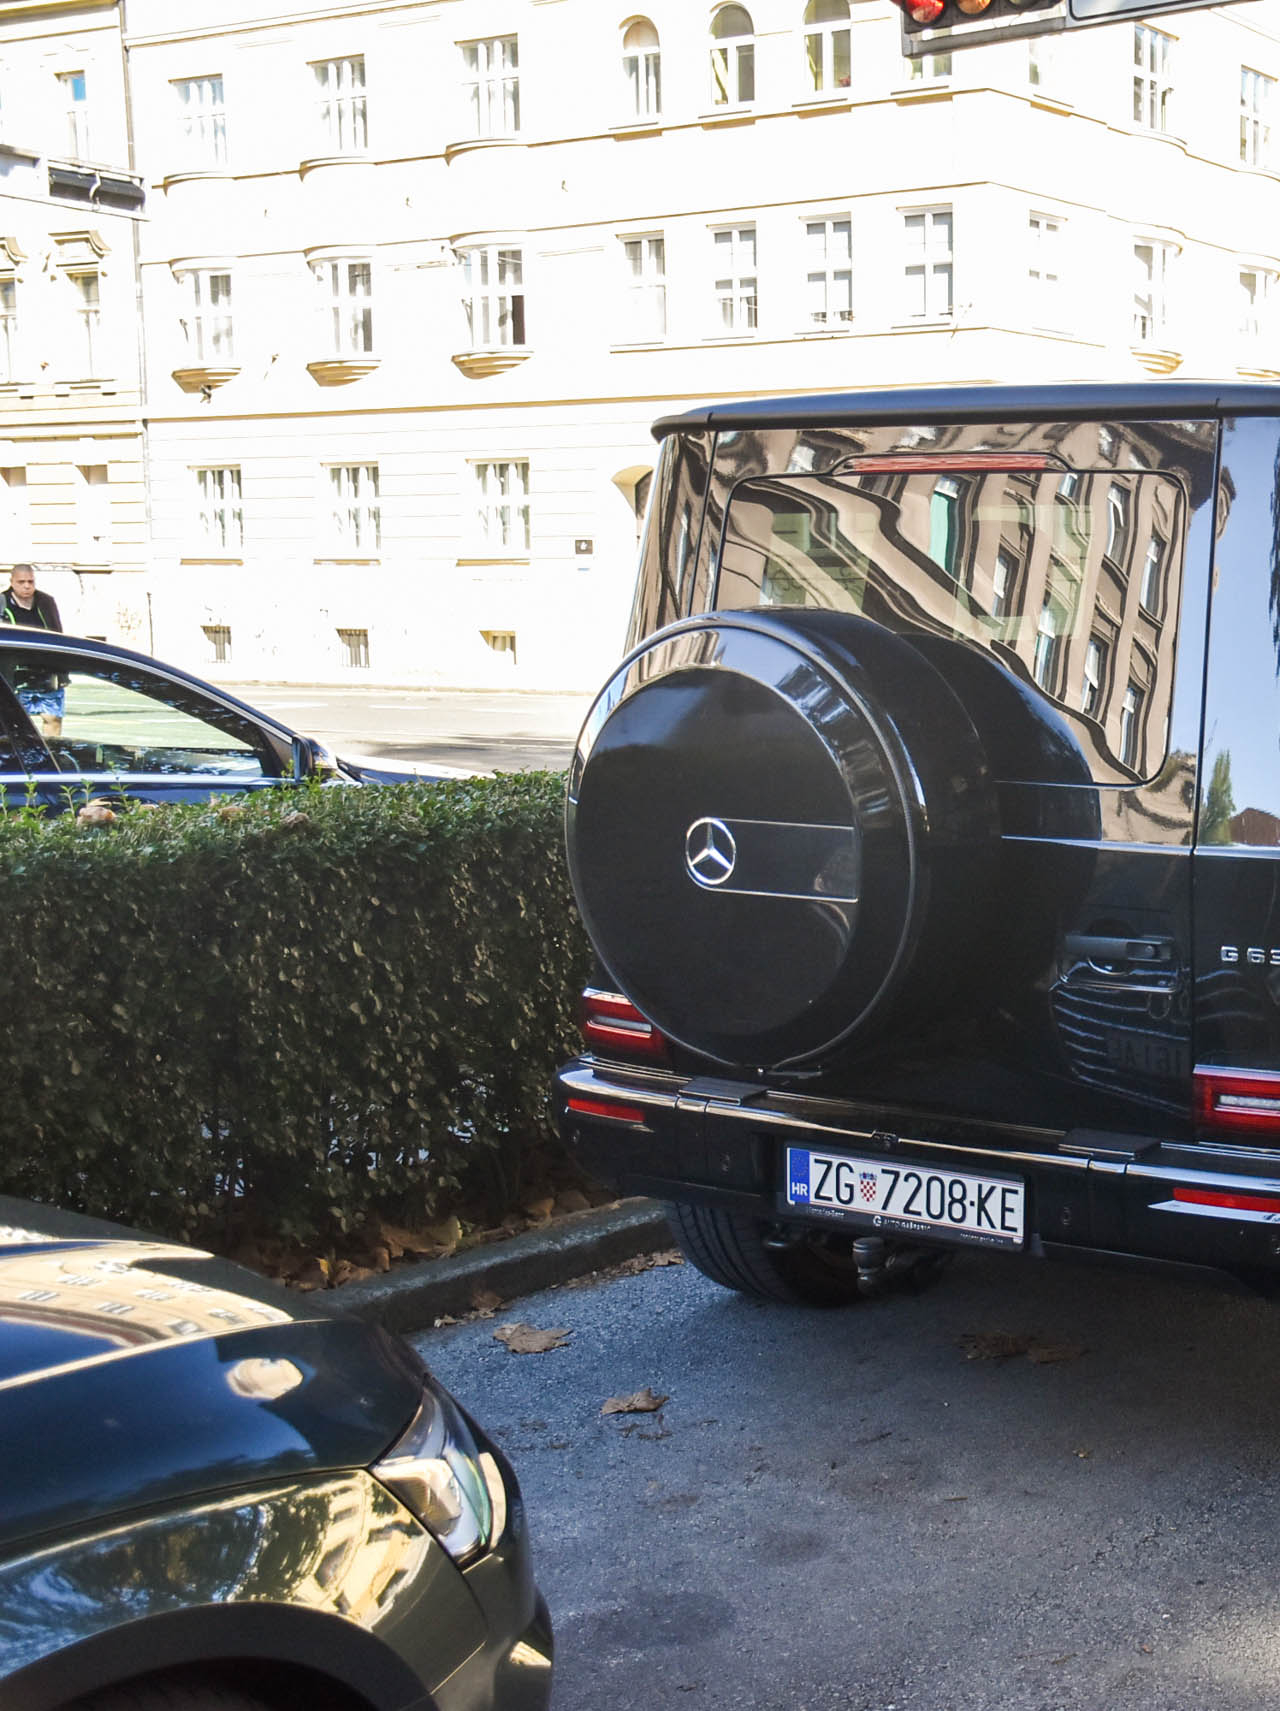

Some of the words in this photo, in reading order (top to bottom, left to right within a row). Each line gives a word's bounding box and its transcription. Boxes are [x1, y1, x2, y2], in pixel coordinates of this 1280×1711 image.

[1220, 945, 1239, 962] G
[791, 1182, 808, 1197] HR
[813, 1158, 855, 1205] ZG
